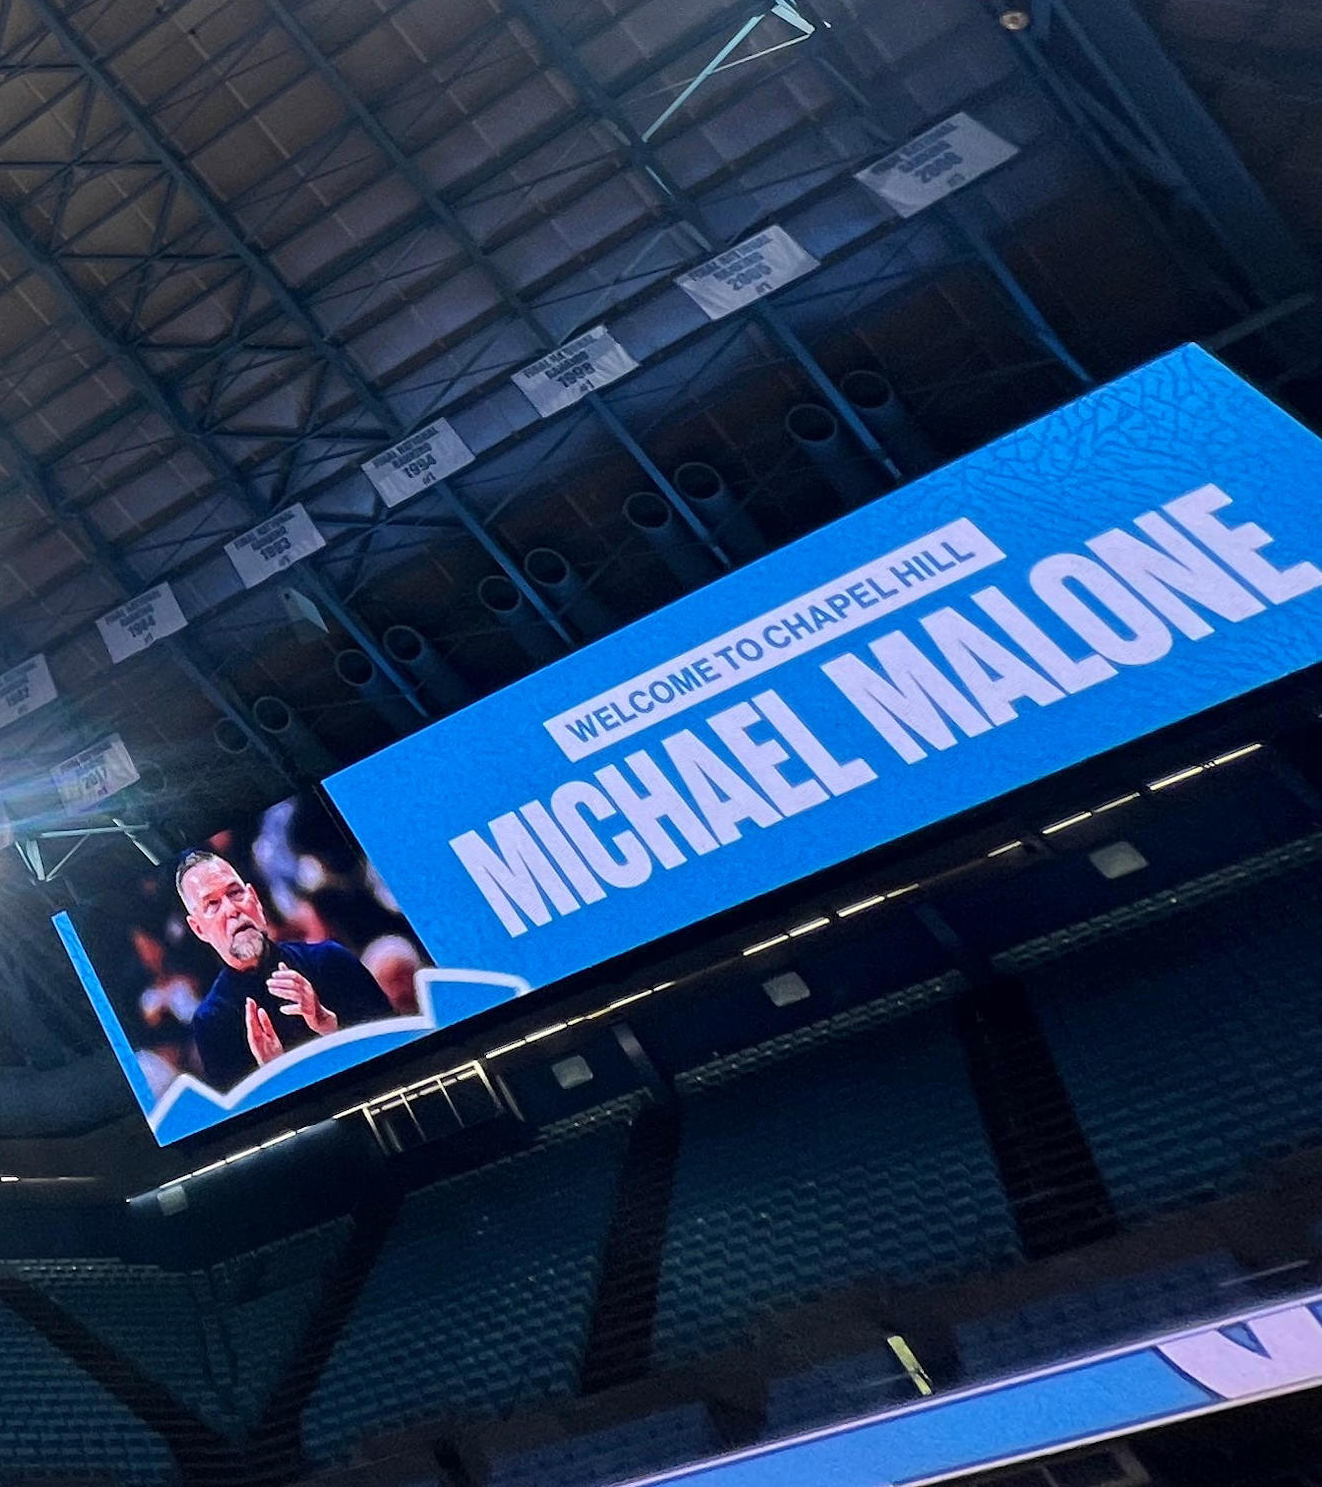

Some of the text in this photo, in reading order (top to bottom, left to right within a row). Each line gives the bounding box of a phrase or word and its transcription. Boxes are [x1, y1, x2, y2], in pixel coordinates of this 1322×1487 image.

[404, 454, 437, 478] 1994
[565, 539, 977, 744] WELCOME TO CHAPEL HILL
[449, 483, 1322, 938] MICHAEL MALONE
[82, 764, 107, 790] 2017
